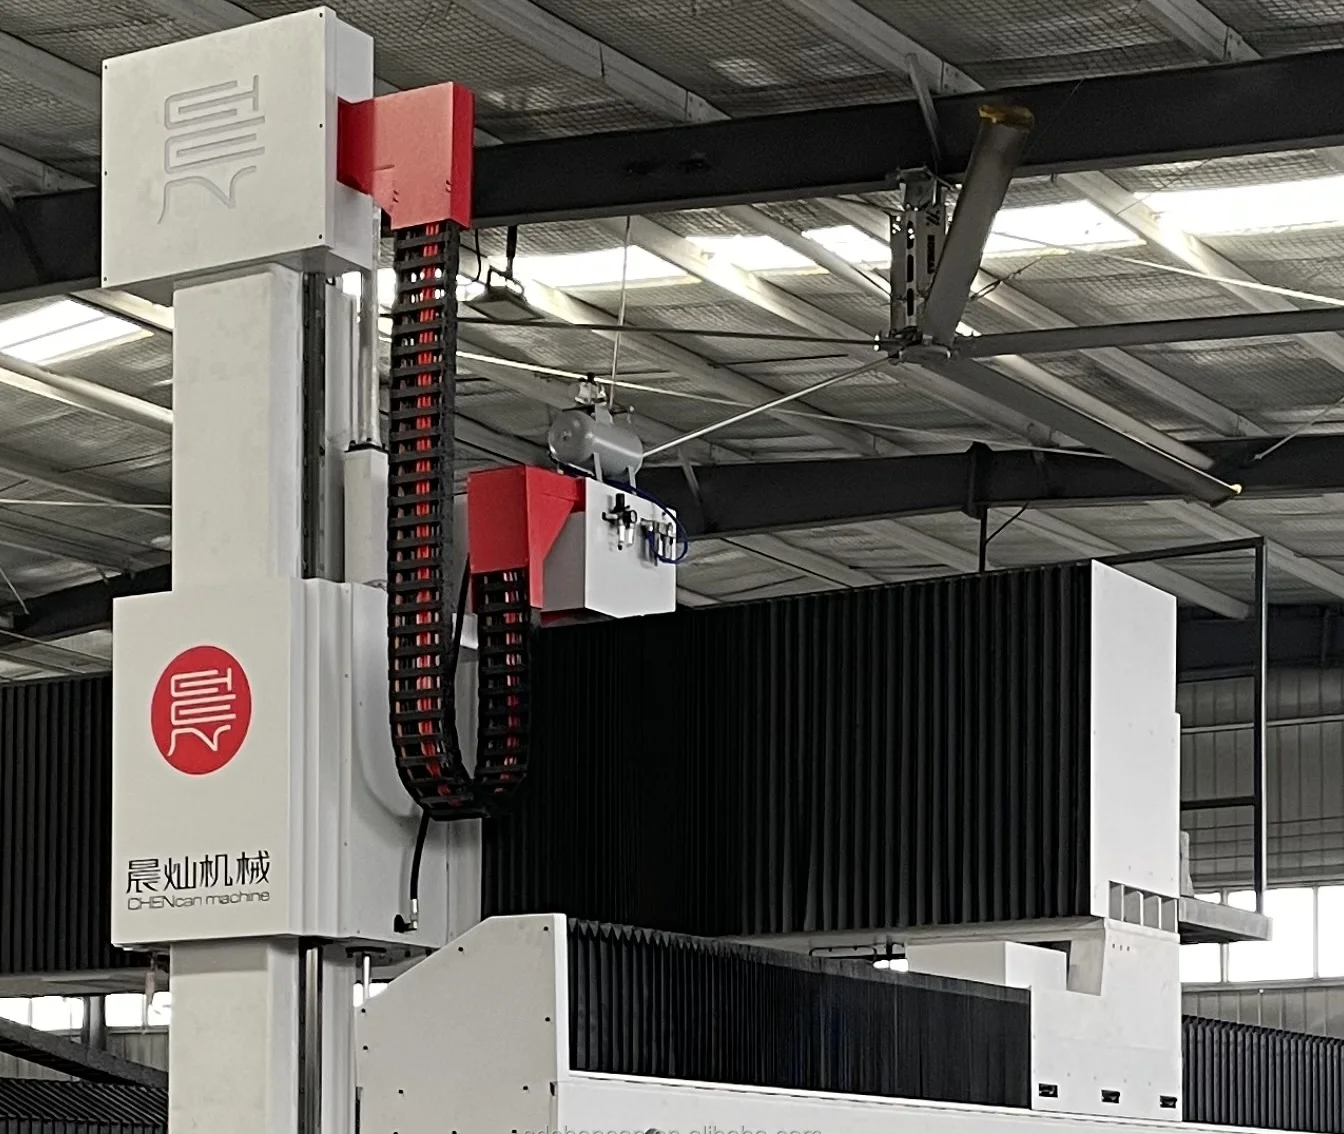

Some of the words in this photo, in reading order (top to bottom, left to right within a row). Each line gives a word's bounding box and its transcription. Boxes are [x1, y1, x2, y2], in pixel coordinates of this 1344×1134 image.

[126, 850, 270, 894] 晨灿机械
[205, 890, 270, 905] machine
